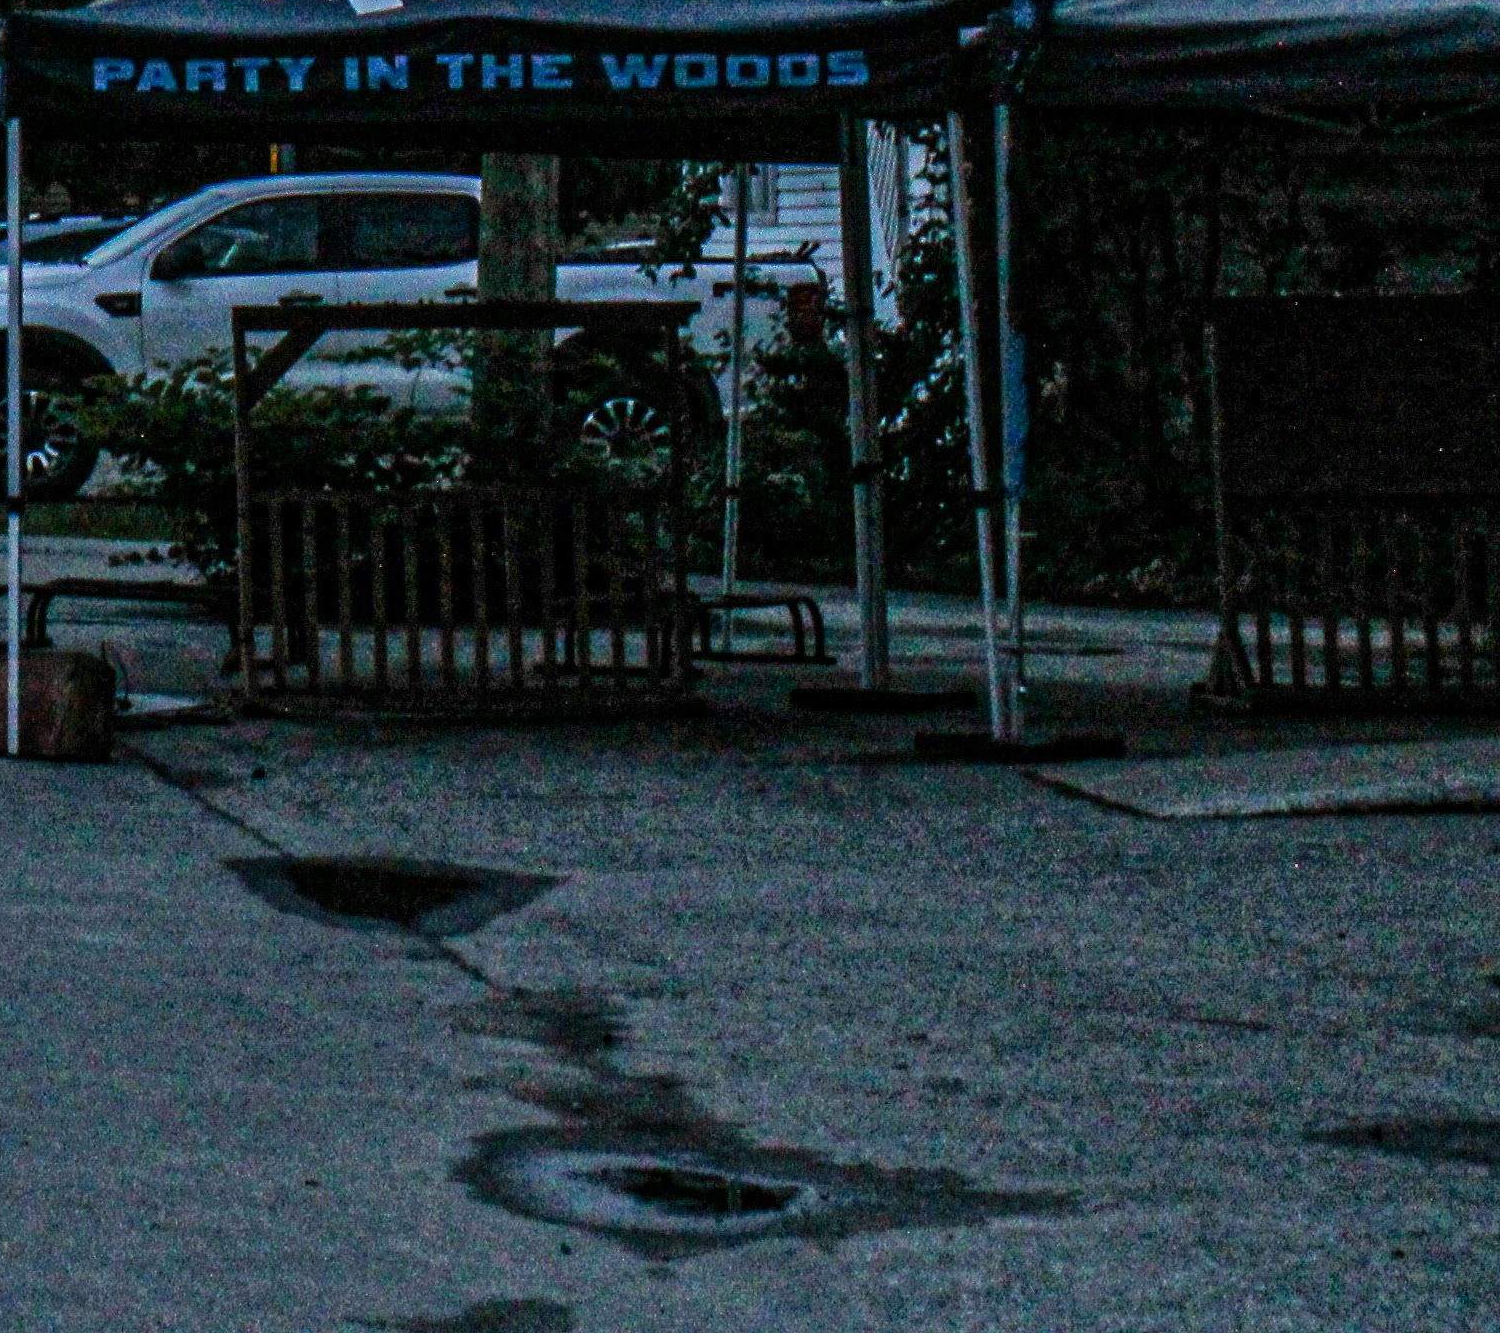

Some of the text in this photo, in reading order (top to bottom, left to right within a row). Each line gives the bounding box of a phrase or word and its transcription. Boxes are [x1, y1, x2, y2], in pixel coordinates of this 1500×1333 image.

[93, 50, 869, 93] PARTY IN THE WOODS
